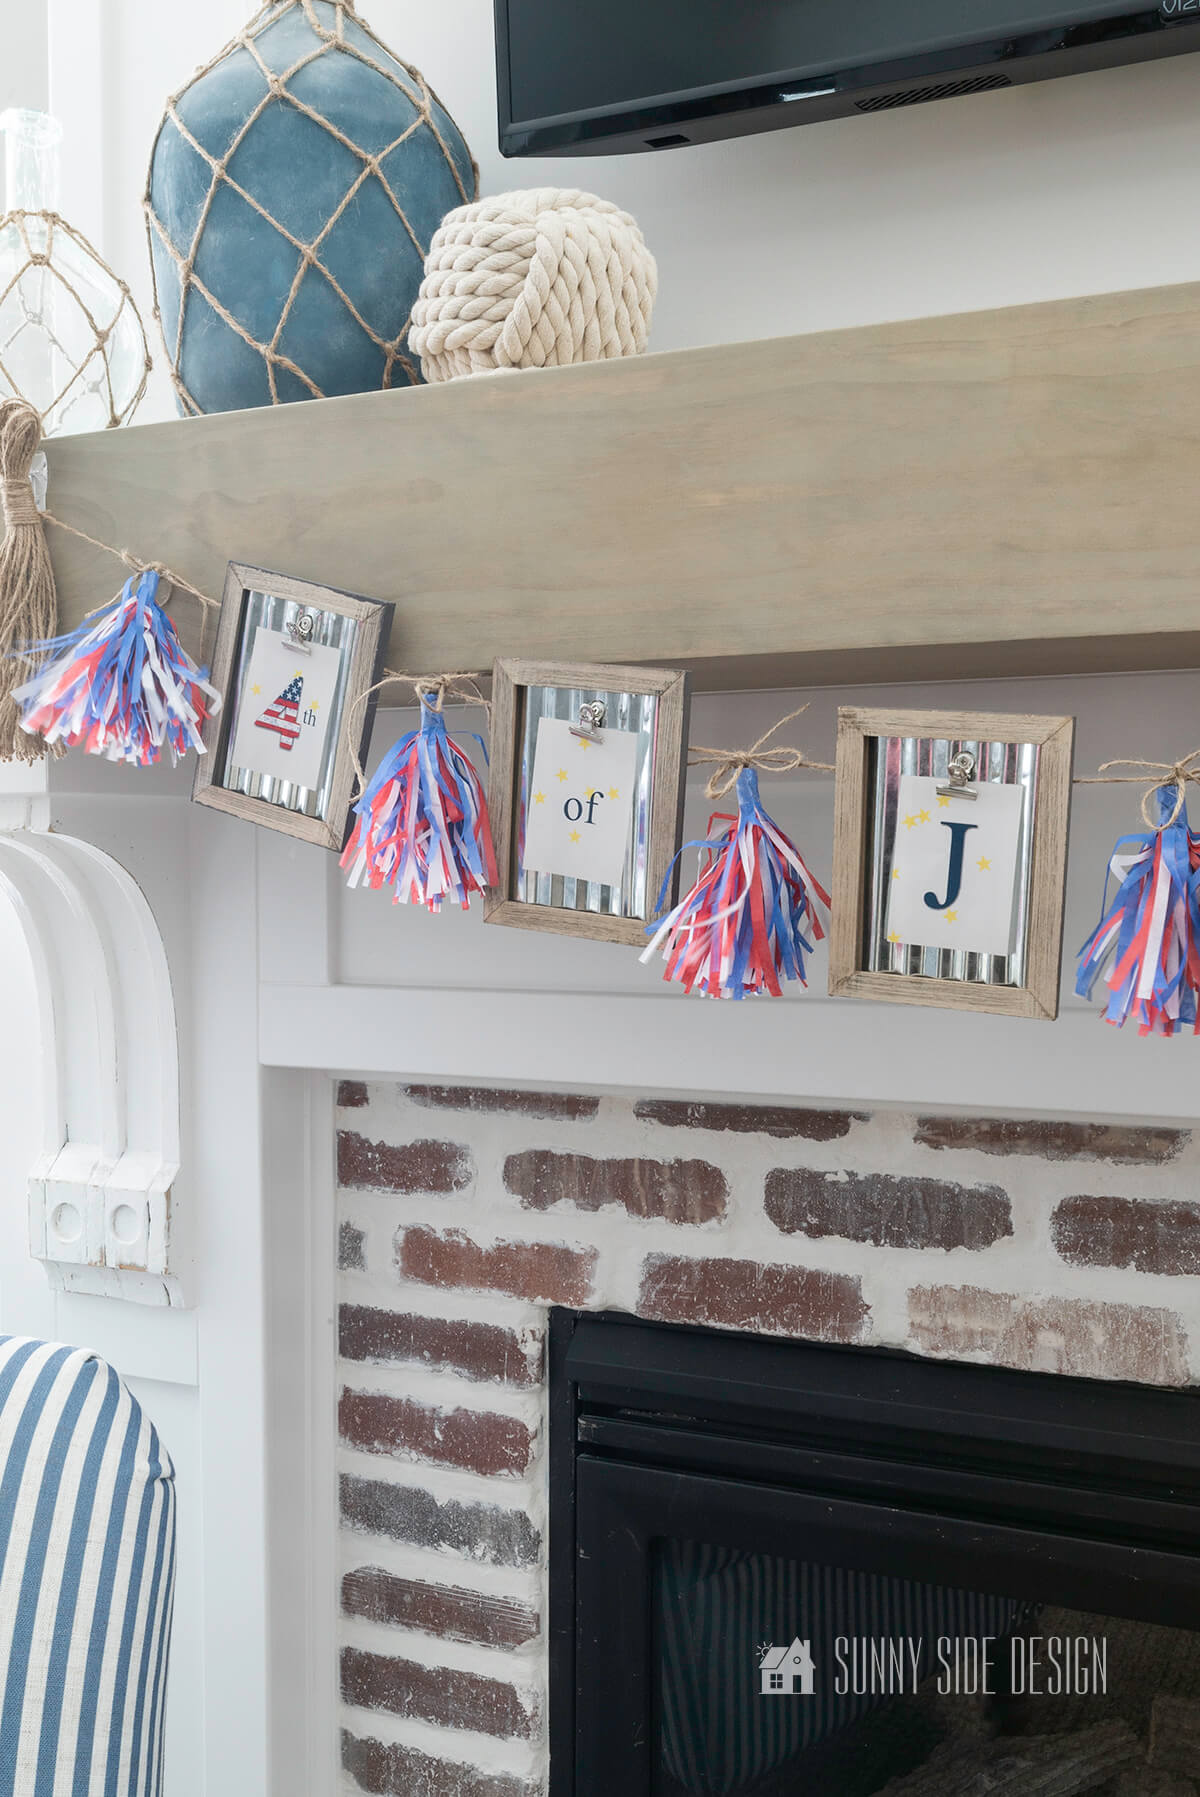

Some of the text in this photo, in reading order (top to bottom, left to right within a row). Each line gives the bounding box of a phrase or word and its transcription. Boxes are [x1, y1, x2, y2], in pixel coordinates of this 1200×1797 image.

[254, 676, 316, 751] 4th
[563, 791, 604, 825] of
[923, 821, 978, 910] J
